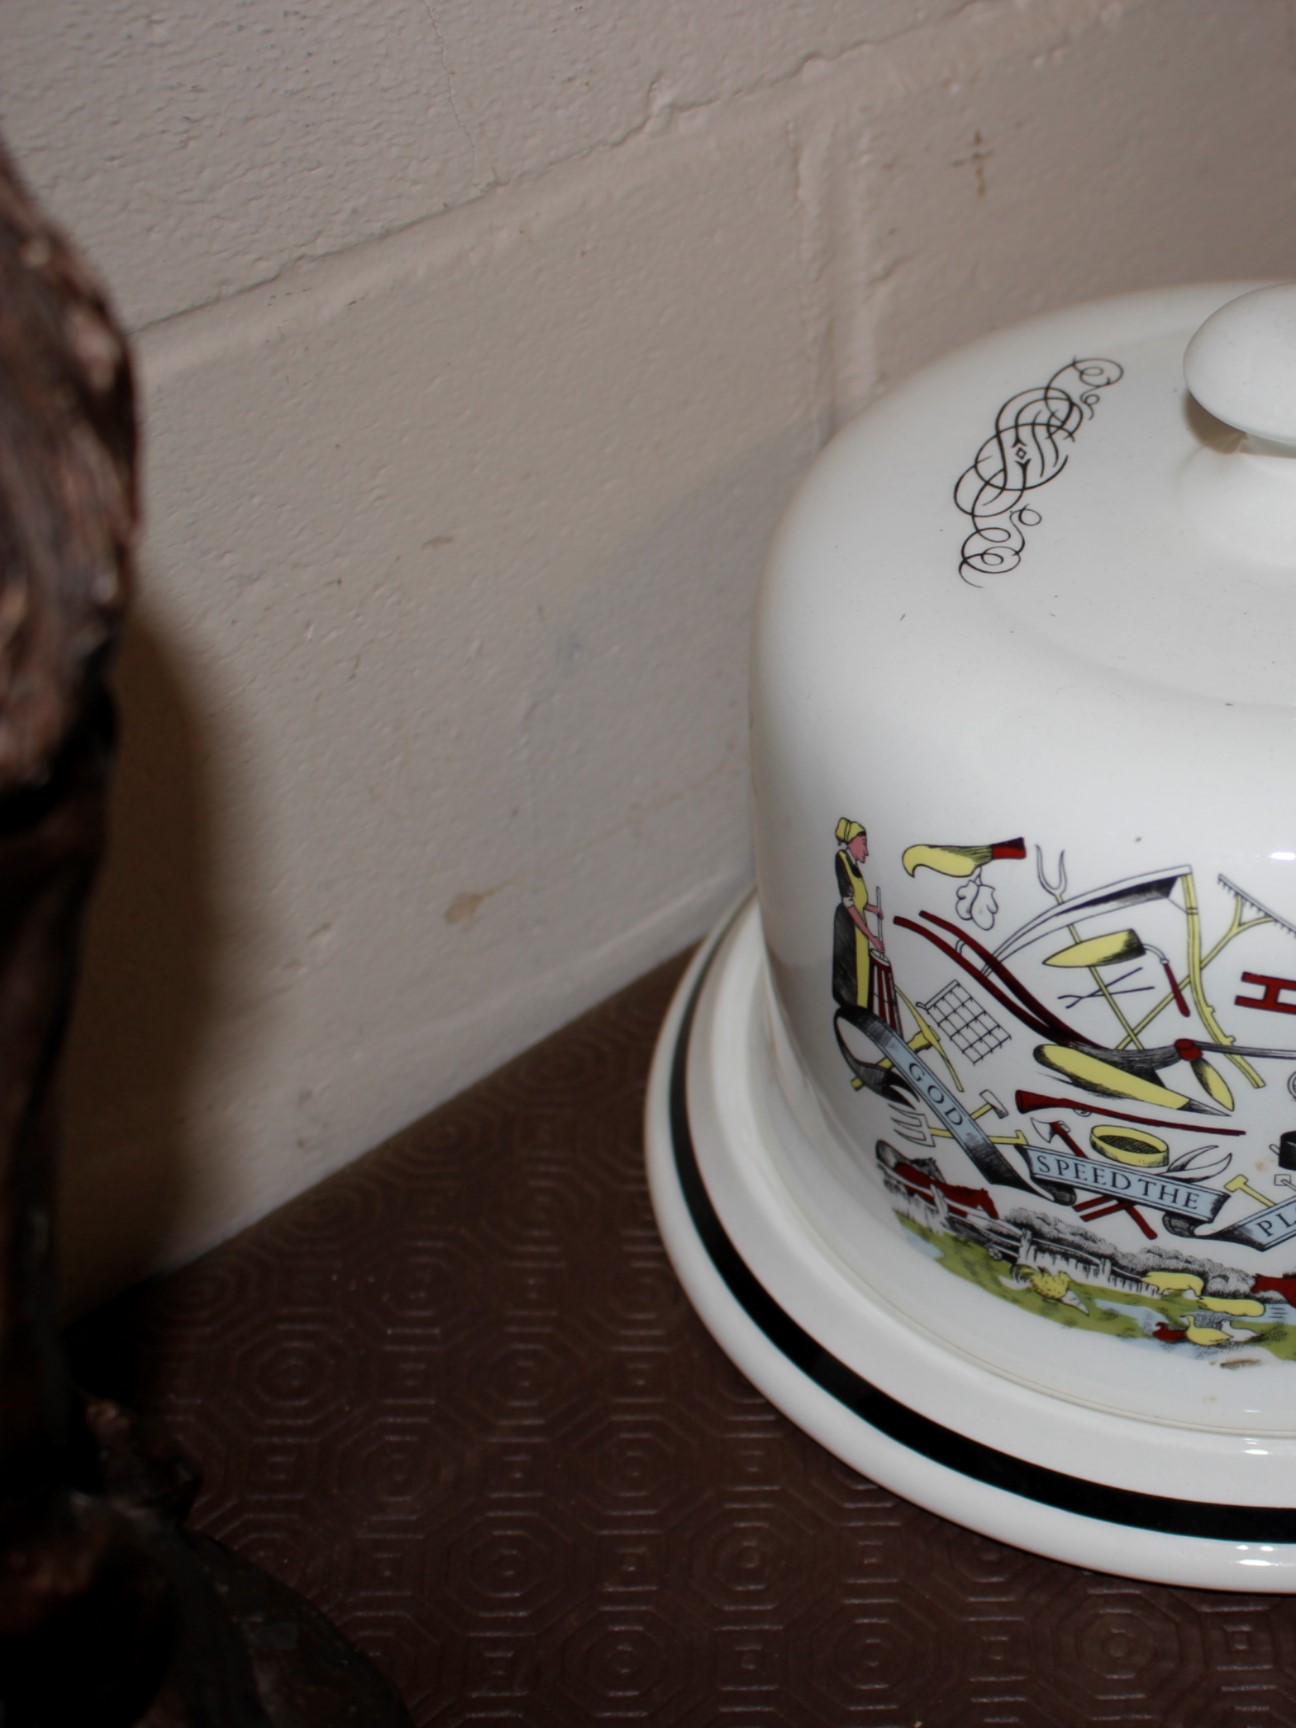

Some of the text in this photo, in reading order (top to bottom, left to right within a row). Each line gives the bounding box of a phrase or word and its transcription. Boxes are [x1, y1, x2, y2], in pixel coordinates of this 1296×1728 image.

[907, 1061, 965, 1127] GOD
[1037, 1154, 1132, 1192] SPEED
[1137, 1177, 1201, 1211] THE
